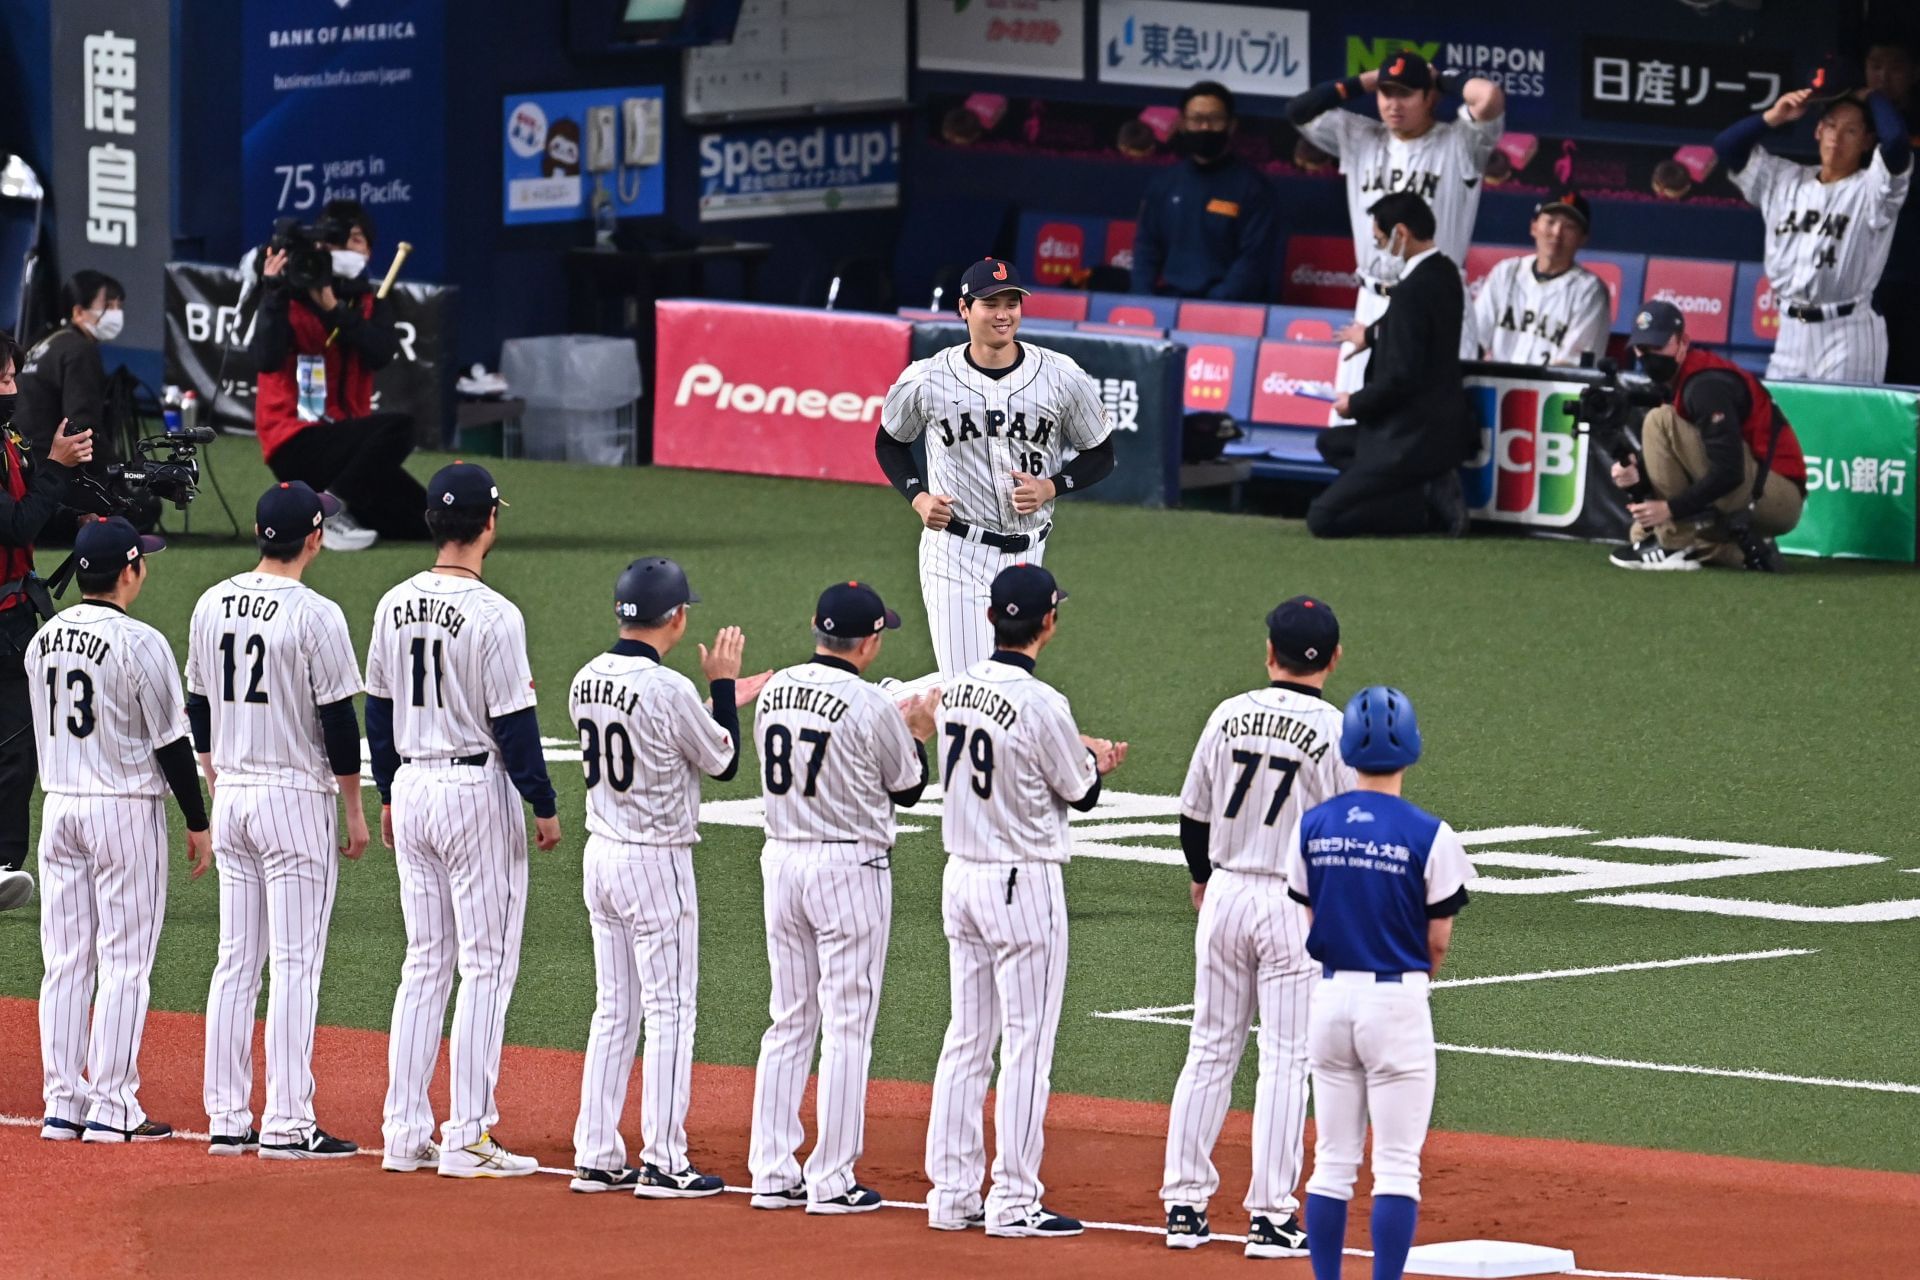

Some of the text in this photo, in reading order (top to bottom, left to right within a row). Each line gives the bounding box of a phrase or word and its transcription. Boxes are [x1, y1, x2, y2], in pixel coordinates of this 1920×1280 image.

[269, 22, 416, 48] BANK OF AMERICA
[1141, 24, 1299, 77] 東急リバブル
[1446, 43, 1545, 73] NIPPON
[1467, 69, 1545, 97] RESS
[1593, 57, 1781, 110] 日産リーフ
[322, 155, 385, 185] years in
[700, 122, 899, 187] Speed up!
[274, 164, 317, 211] 75
[360, 178, 412, 203] Pacific
[1499, 304, 1569, 348] APAN
[674, 363, 884, 422] Pioneer
[1099, 377, 1139, 432] 設
[939, 410, 1053, 447] JAPAN
[1461, 427, 1575, 475] JCB
[1019, 452, 1043, 477] 16
[222, 594, 279, 622] TOGO
[393, 597, 466, 638] DARVISH
[623, 603, 637, 617] 90
[39, 628, 110, 666] MATSUI
[219, 632, 268, 705] 12
[409, 637, 444, 709] 11
[46, 666, 96, 739] 13
[762, 686, 849, 723] SHIMIZU
[577, 717, 635, 793] 90
[764, 723, 831, 797] 87
[944, 721, 994, 800] 79
[1221, 712, 1331, 764] YOSHIMURA
[1223, 748, 1302, 827] 77
